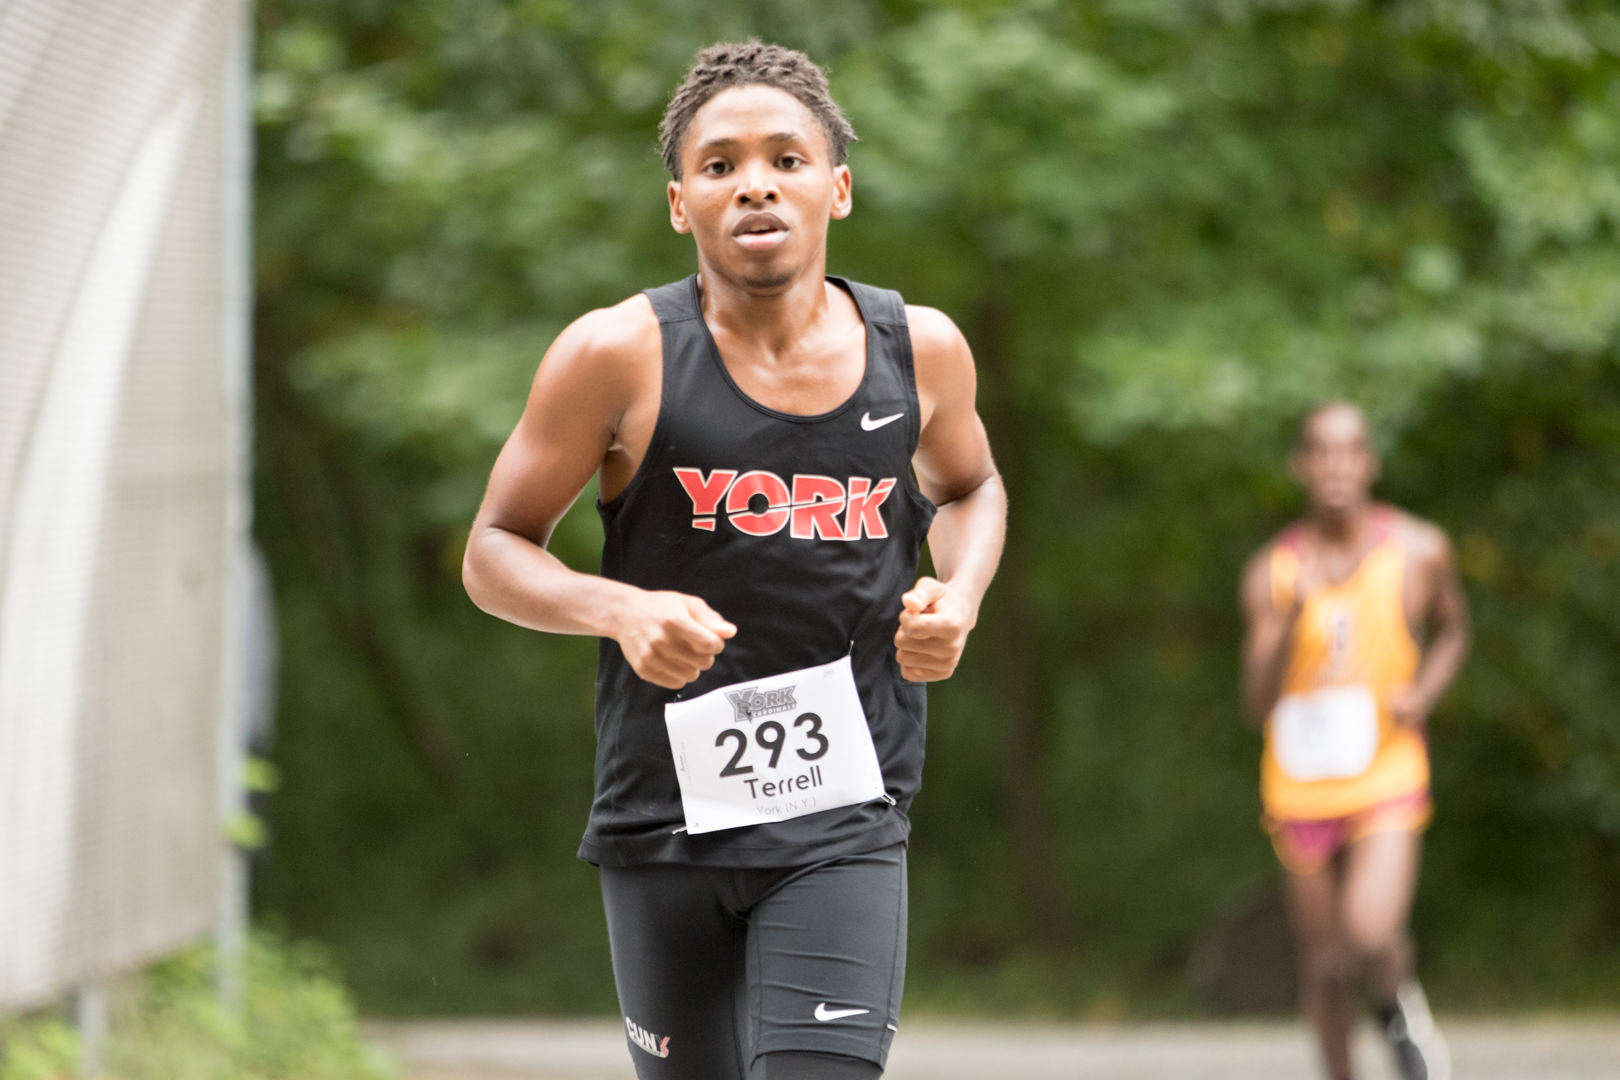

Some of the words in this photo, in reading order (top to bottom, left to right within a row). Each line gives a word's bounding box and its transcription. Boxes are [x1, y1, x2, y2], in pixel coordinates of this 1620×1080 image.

[672, 466, 897, 541] YORK
[724, 686, 797, 722] YORK
[752, 703, 797, 718] CARDINALS
[715, 712, 829, 778] 293
[743, 765, 823, 799] Terrell
[757, 804, 782, 816] York
[785, 796, 817, 813] (N.Y.)
[625, 1016, 671, 1057] CUNY
